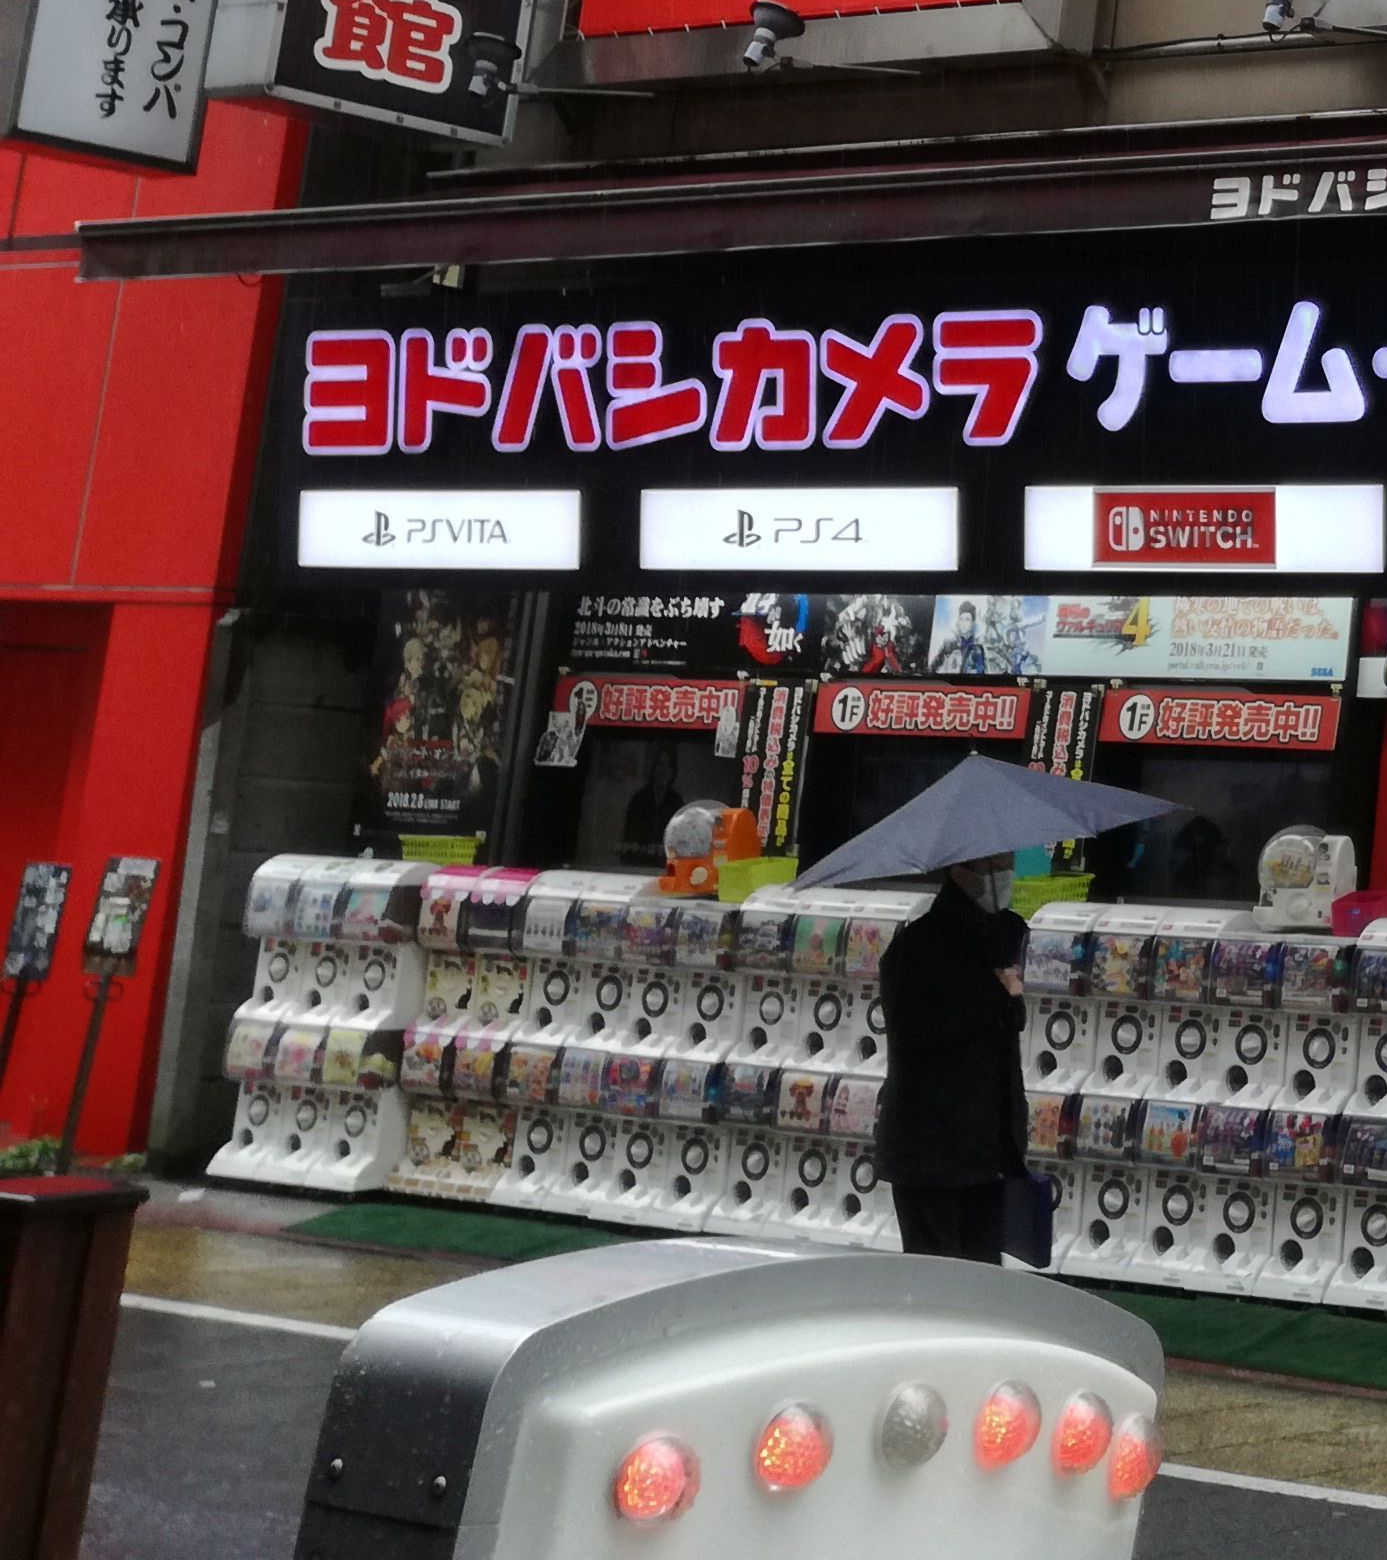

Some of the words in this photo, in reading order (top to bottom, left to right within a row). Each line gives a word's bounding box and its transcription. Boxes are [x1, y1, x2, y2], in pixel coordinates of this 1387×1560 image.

[303, 309, 1044, 456] ヨドバシカメラ
[1150, 509, 1252, 522] NINTENDO
[772, 516, 865, 545] PS4
[1149, 525, 1253, 550] SWITCH
